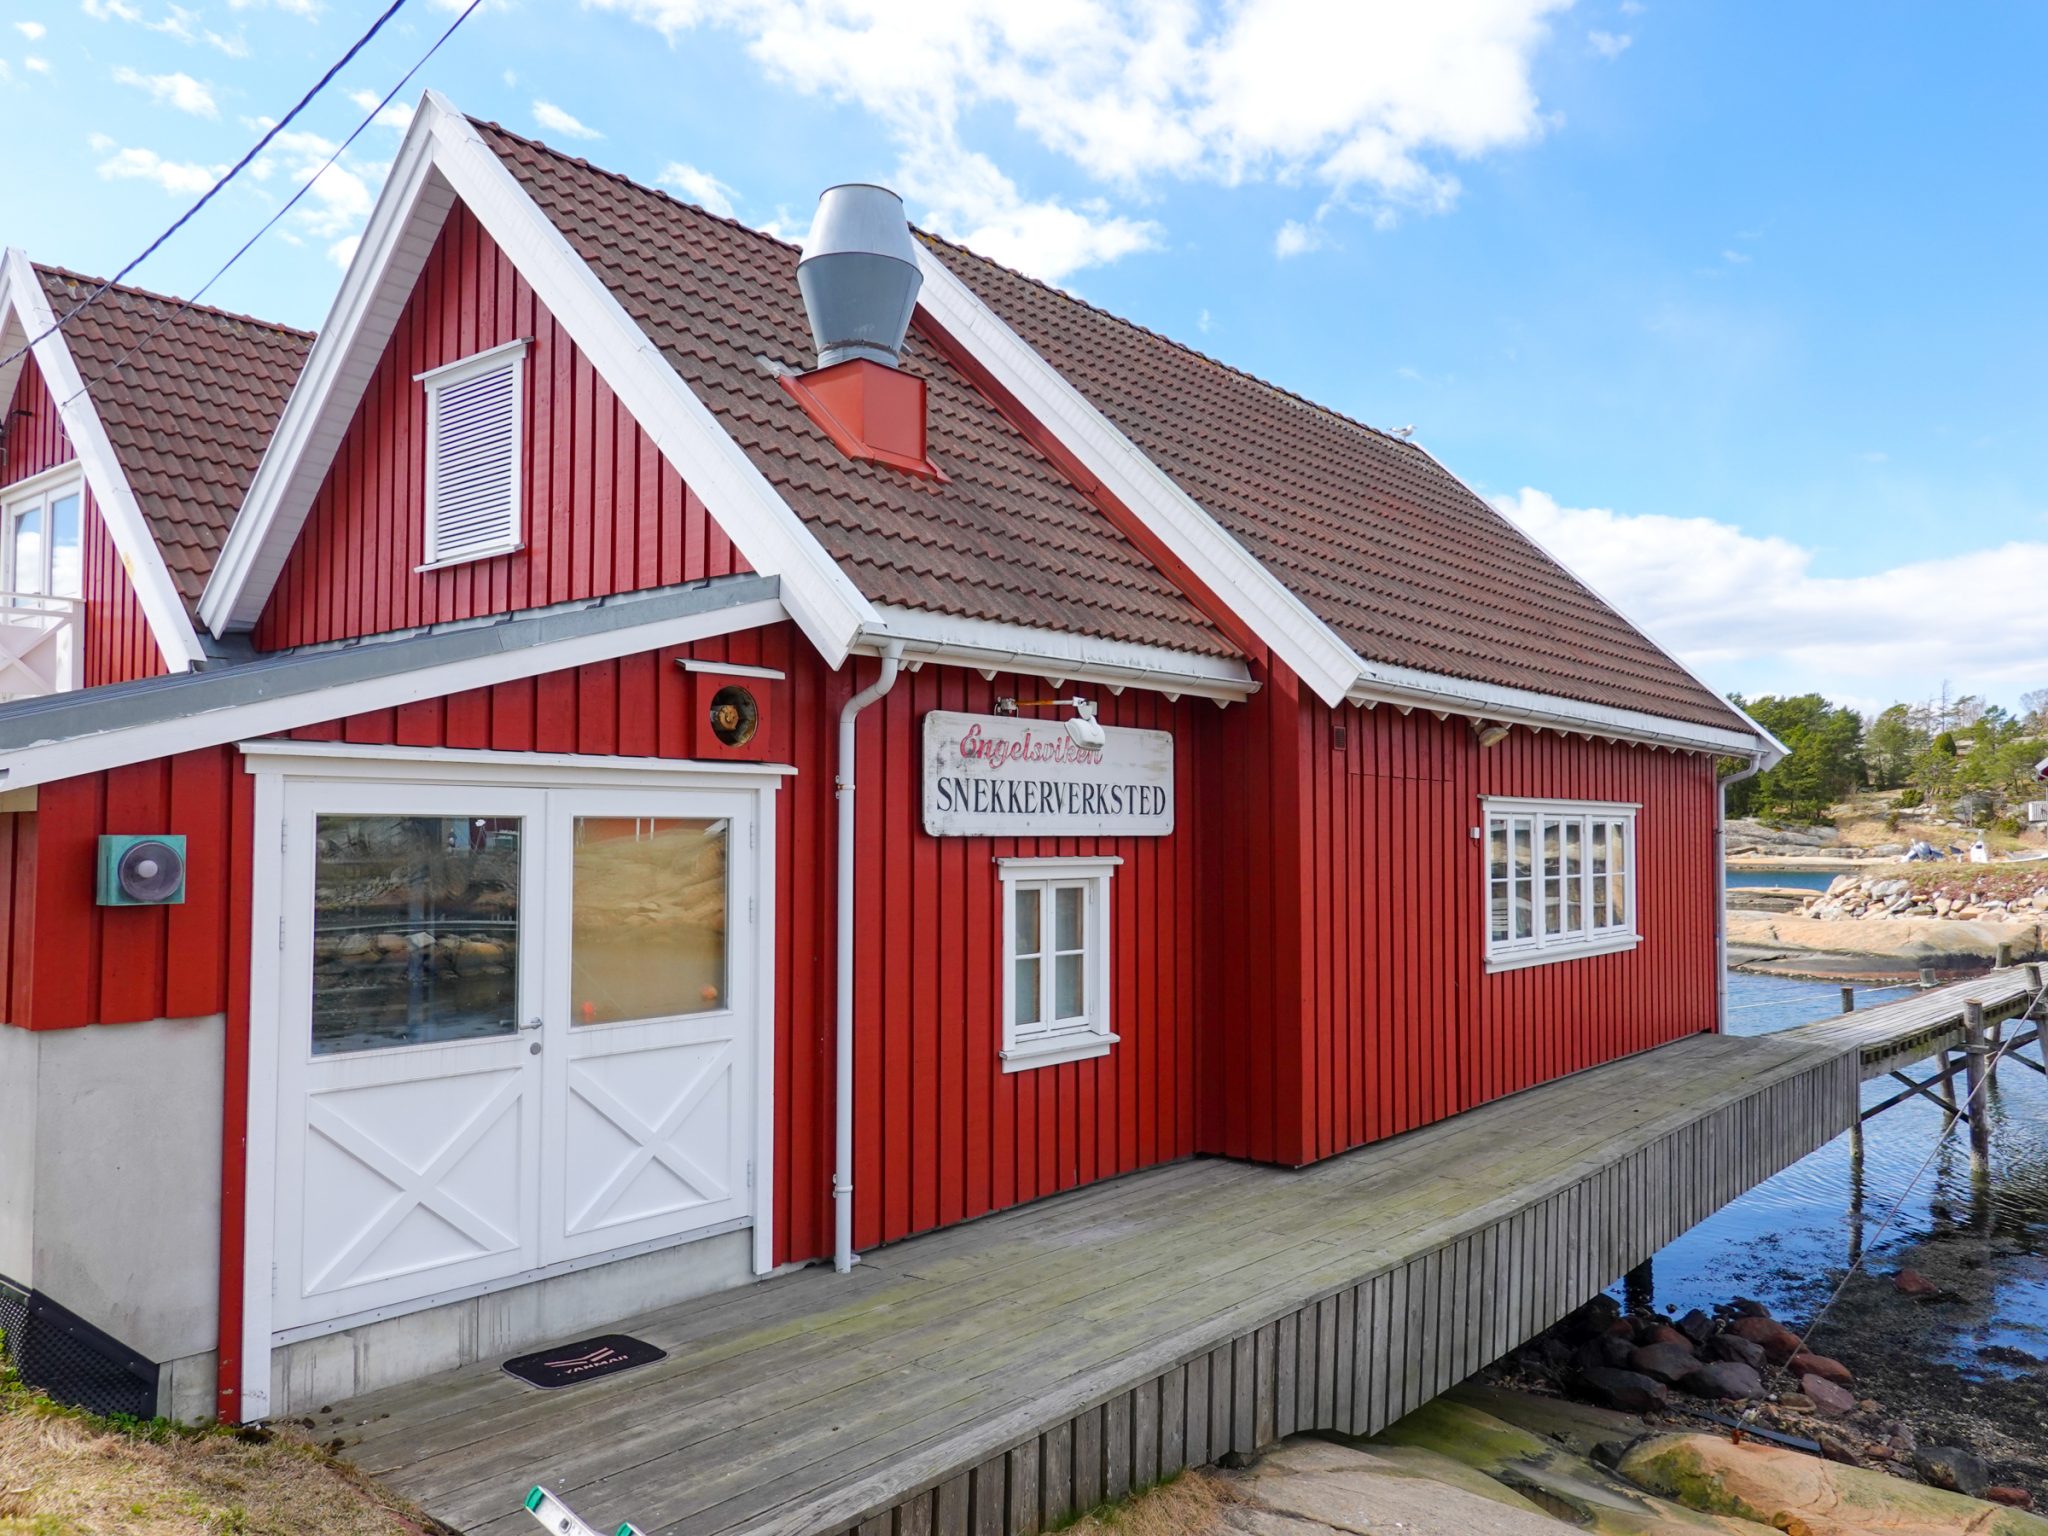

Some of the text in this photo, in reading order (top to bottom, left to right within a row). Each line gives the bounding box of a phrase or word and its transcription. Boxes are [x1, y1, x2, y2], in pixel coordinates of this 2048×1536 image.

[960, 723, 1103, 769] Engelsviken
[937, 776, 1166, 816] SNEKKERVERKSTED
[564, 1354, 628, 1374] YANMAR
